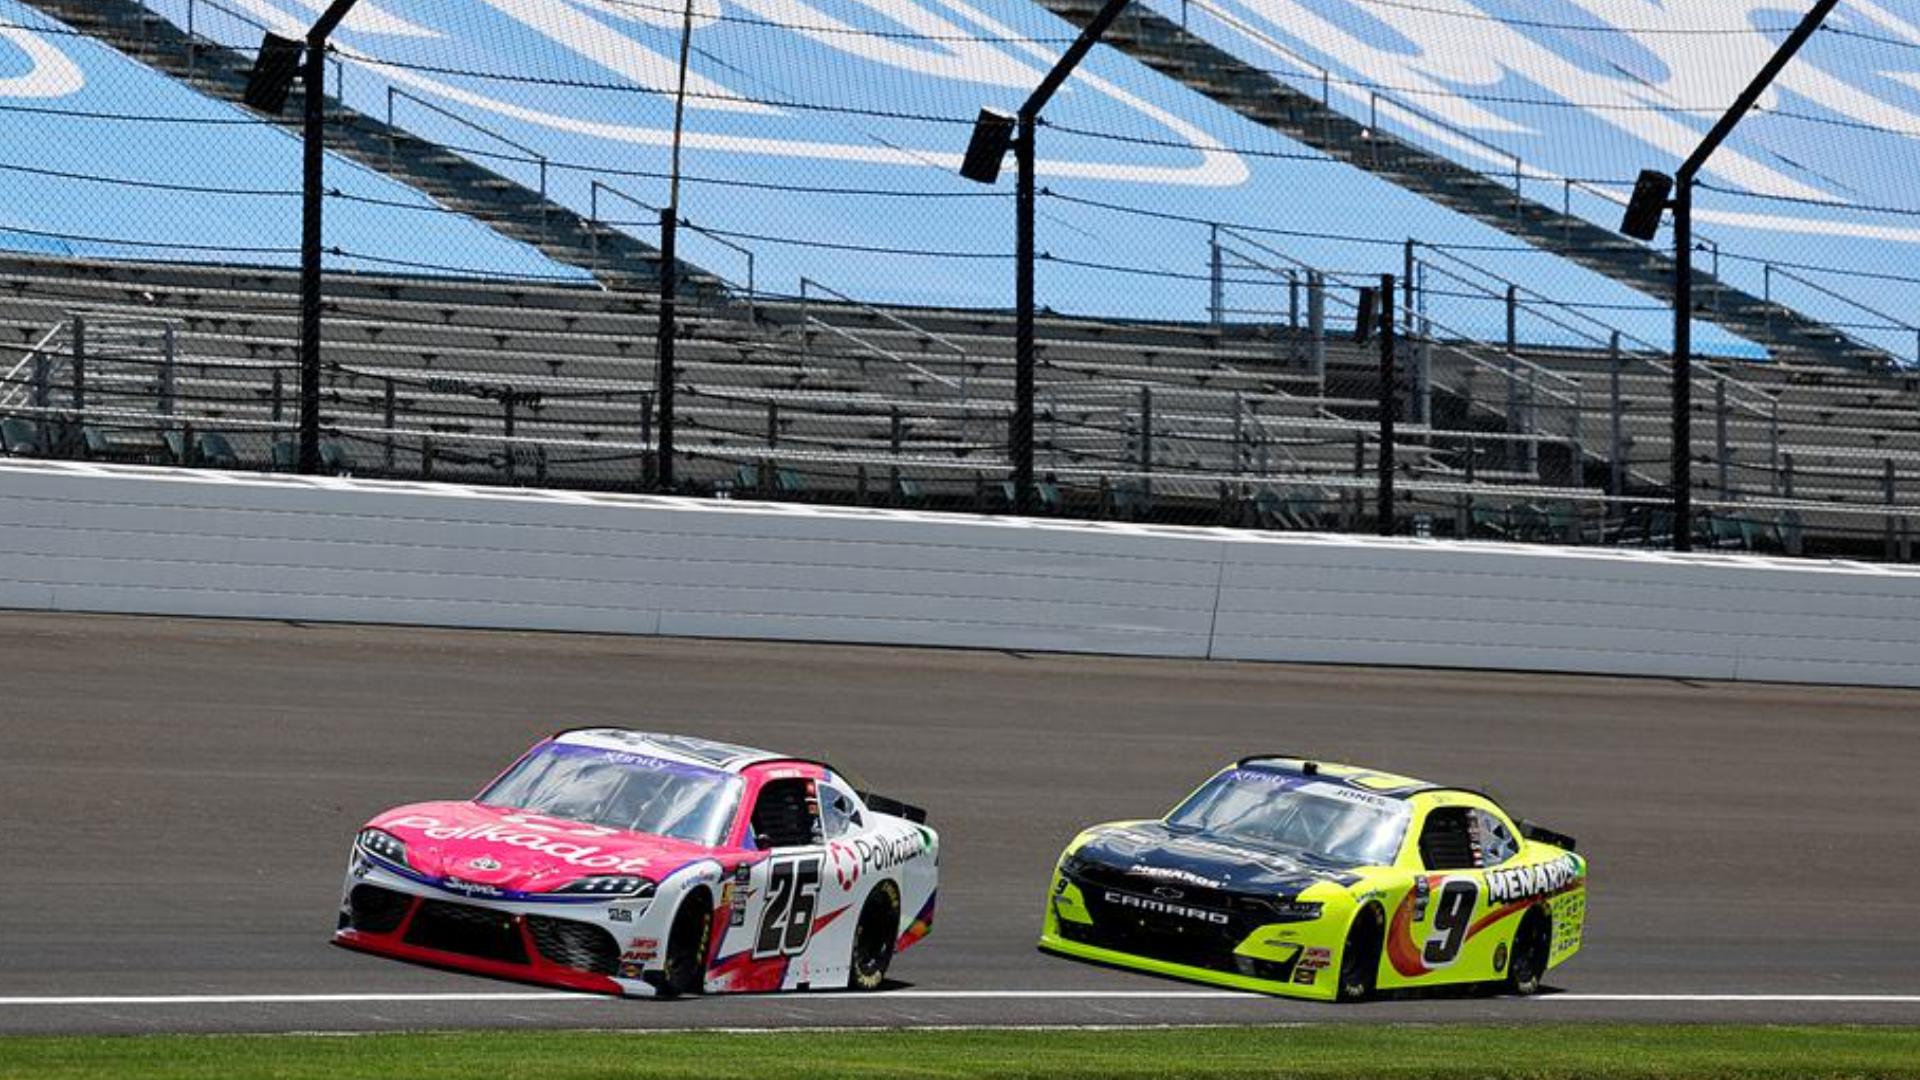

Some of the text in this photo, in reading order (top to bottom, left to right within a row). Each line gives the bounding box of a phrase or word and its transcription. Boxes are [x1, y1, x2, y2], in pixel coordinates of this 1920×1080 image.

[1337, 789, 1386, 806] JONES
[382, 816, 650, 874] Polkadot
[755, 858, 822, 955] 26
[1054, 877, 1069, 895] 9
[1104, 891, 1229, 925] CAMARO
[1424, 879, 1480, 964] 9
